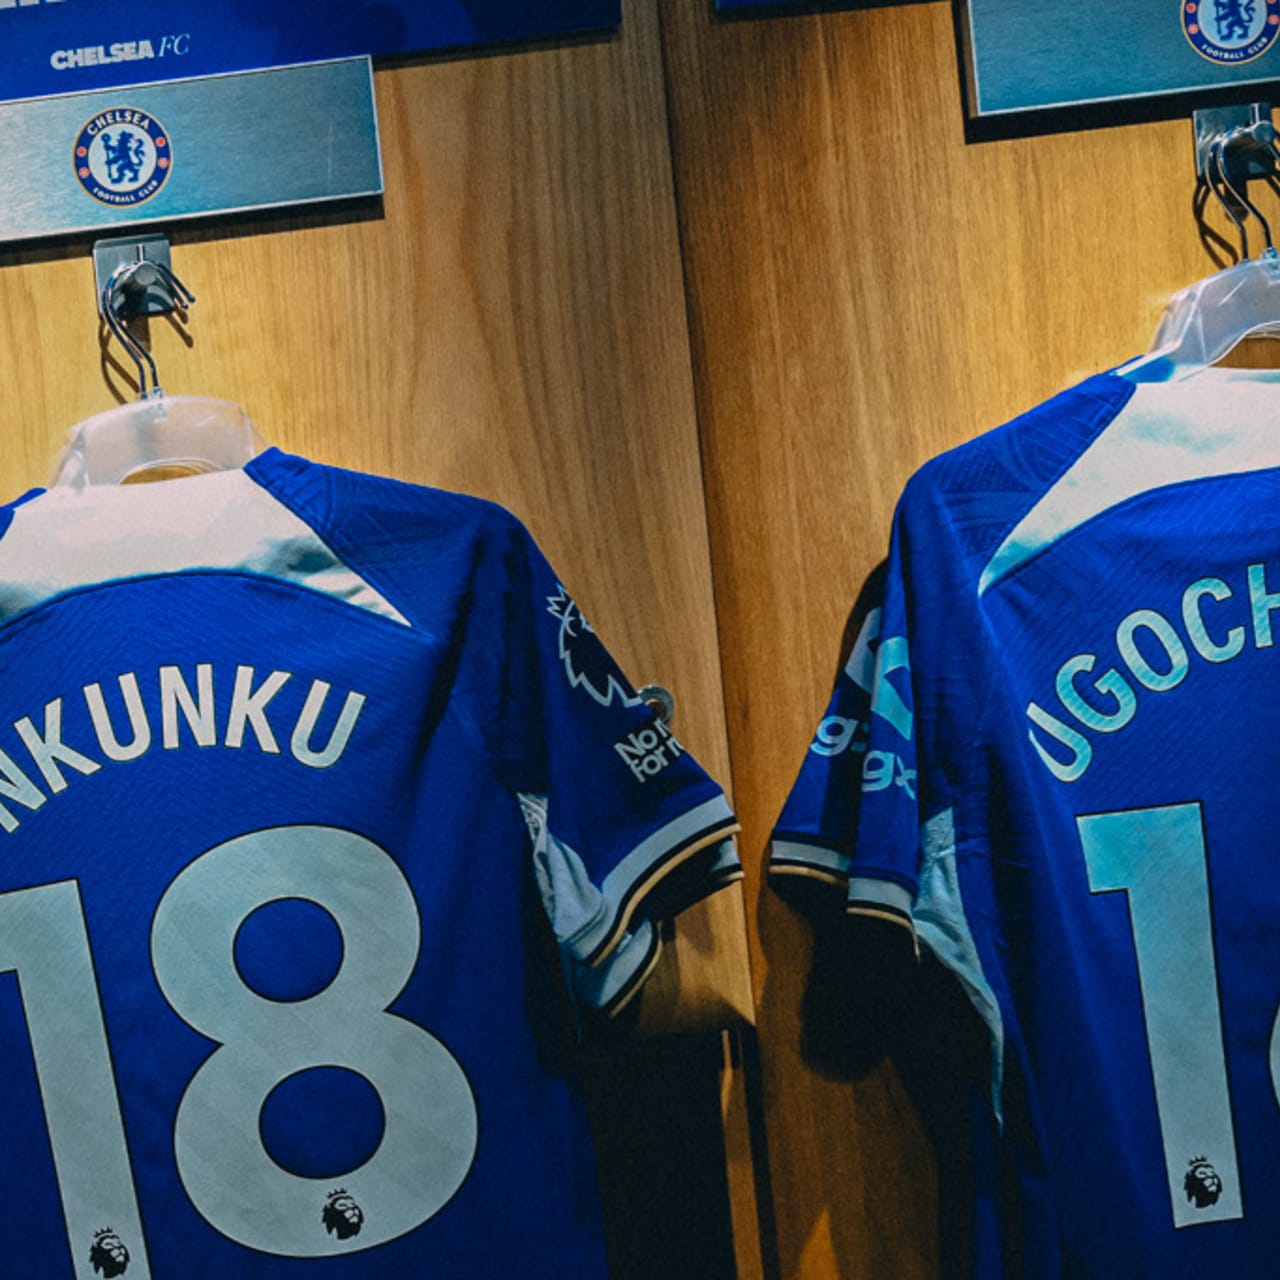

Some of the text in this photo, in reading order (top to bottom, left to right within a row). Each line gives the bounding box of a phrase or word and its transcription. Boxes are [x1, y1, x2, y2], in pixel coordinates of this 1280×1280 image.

[50, 33, 190, 70] CHELSEA FC
[87, 111, 150, 135] CHELSEA
[613, 729, 658, 765] No
